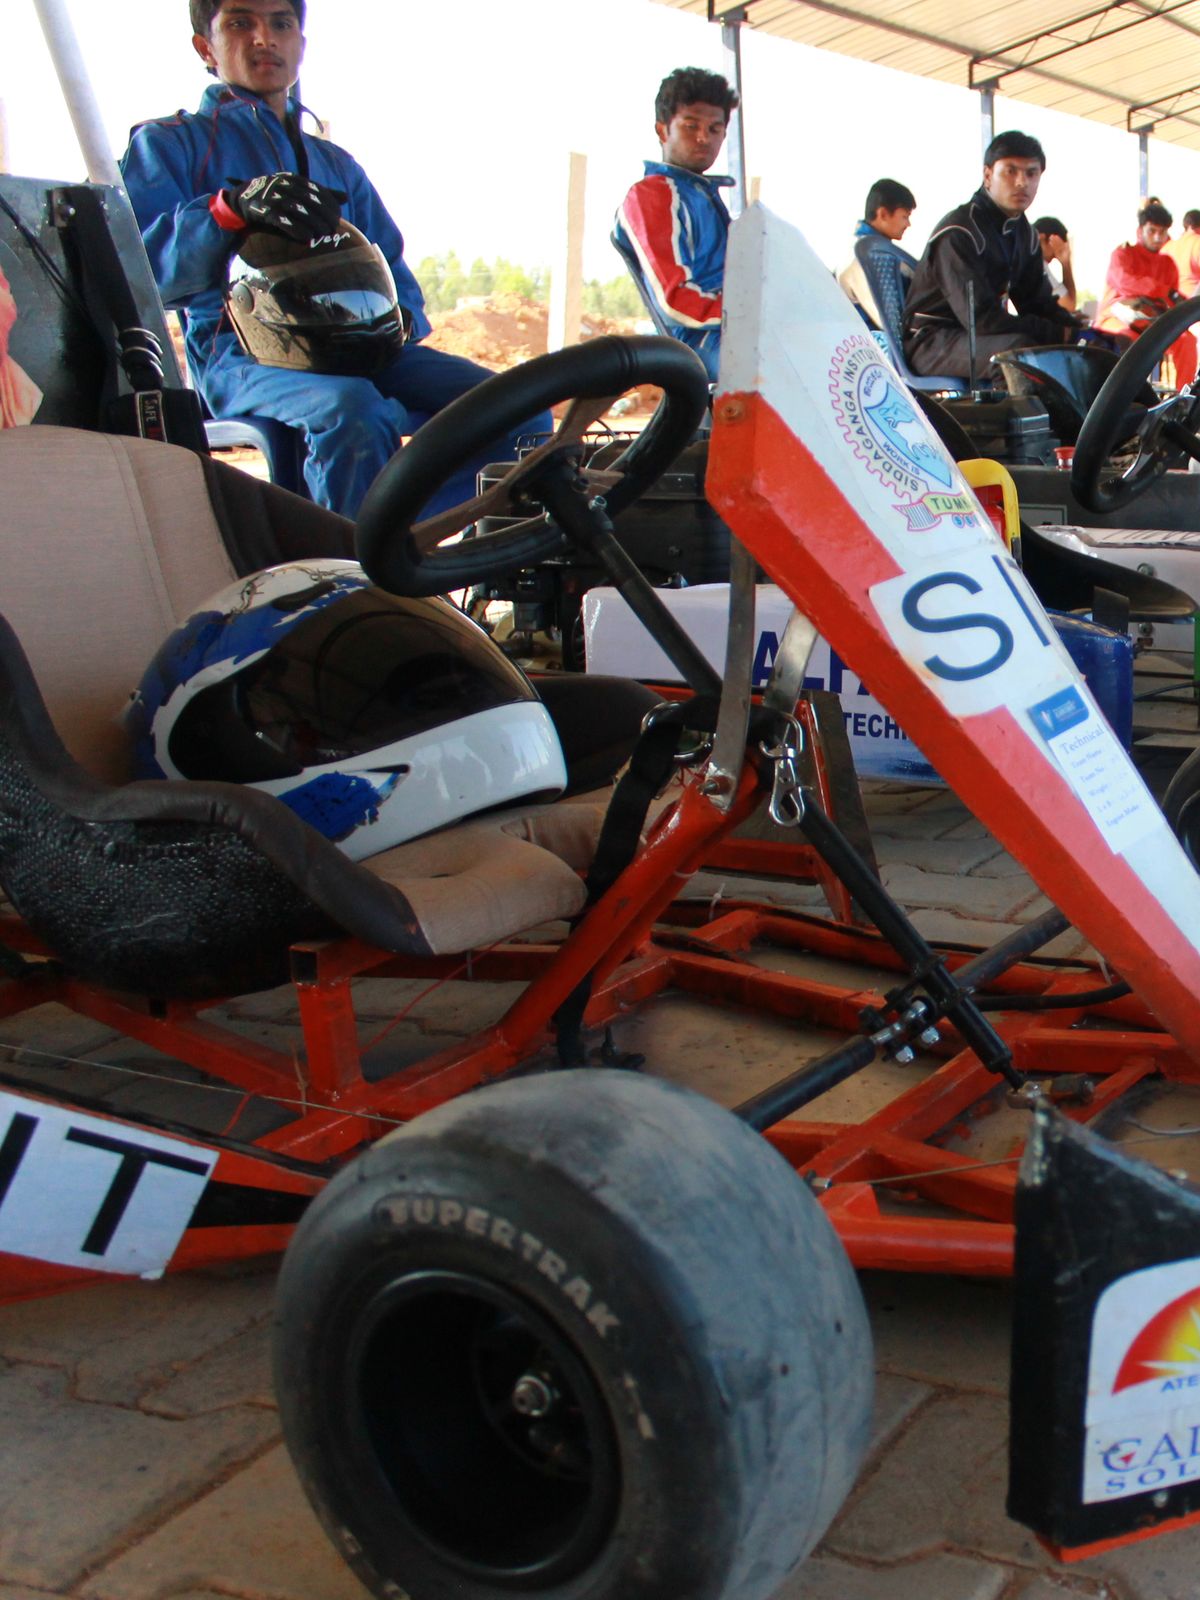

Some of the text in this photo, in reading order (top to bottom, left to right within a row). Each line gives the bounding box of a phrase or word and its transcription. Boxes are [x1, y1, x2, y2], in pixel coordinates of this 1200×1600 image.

[843, 389, 919, 491] SIDDAGANGA
[883, 440, 909, 468] WORK
[930, 497, 968, 511] TUM
[901, 554, 1051, 682] SI
[841, 711, 911, 741] TECH
[1060, 723, 1105, 755] Technical
